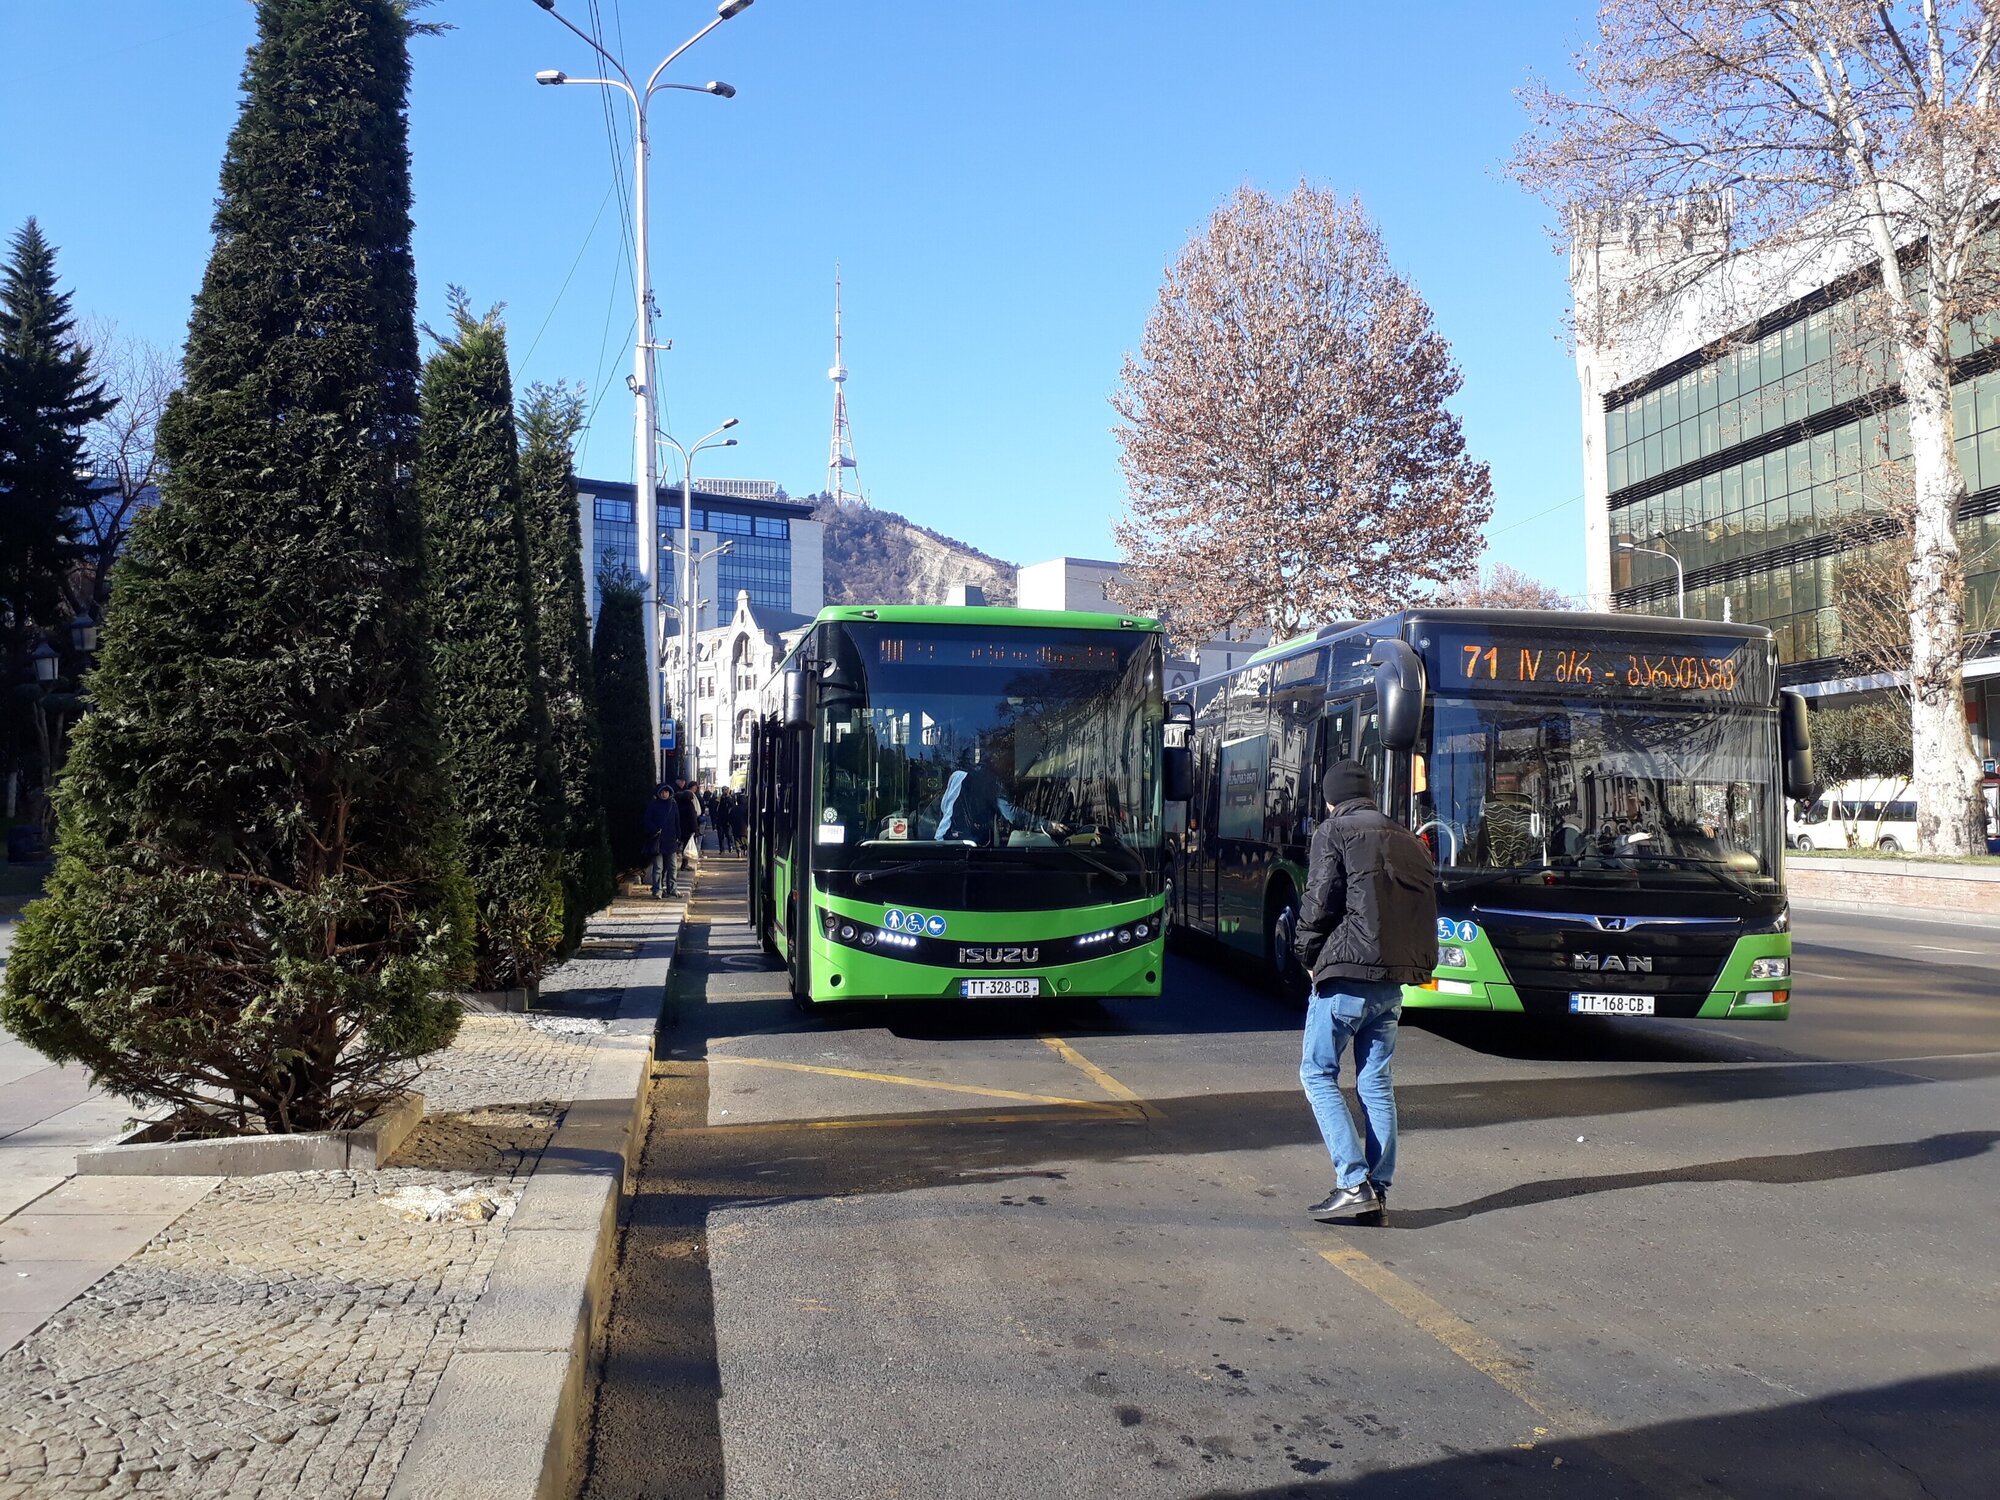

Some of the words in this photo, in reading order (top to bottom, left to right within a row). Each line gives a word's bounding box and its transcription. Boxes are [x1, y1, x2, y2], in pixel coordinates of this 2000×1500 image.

[1463, 645, 1498, 680] 71
[1520, 649, 1543, 682] IV
[959, 947, 1039, 963] ISUZU
[1573, 953, 1652, 972] MAN
[971, 981, 1030, 994] TT-328-CB
[1581, 996, 1644, 1012] TT-168-CB
